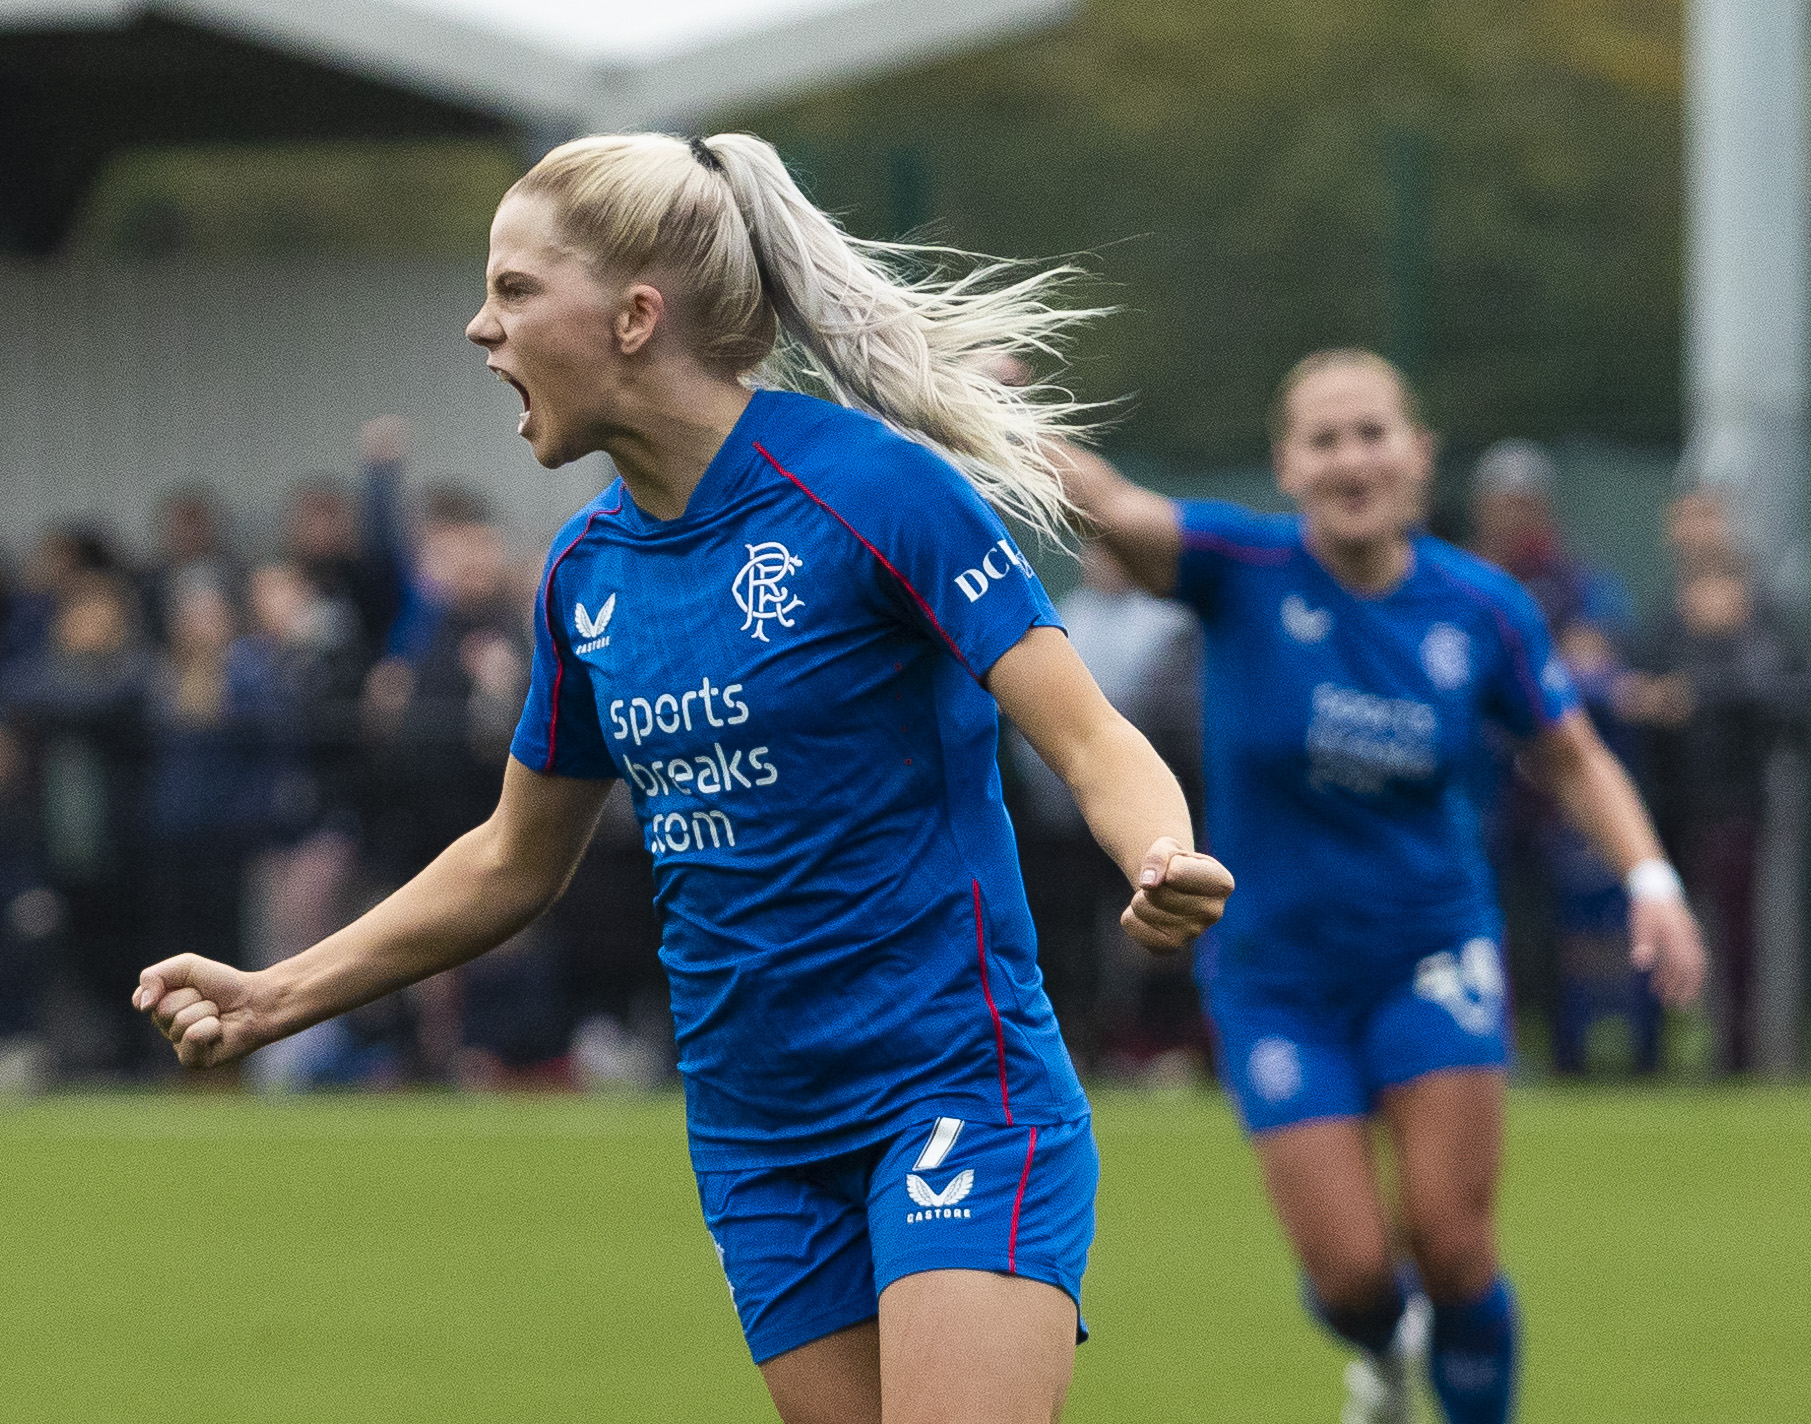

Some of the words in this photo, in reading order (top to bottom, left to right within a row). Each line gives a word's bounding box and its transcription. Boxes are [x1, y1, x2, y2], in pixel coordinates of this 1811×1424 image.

[610, 676, 750, 746] sports
[622, 742, 778, 797] breaks
[906, 1208, 971, 1224] CASTORE
